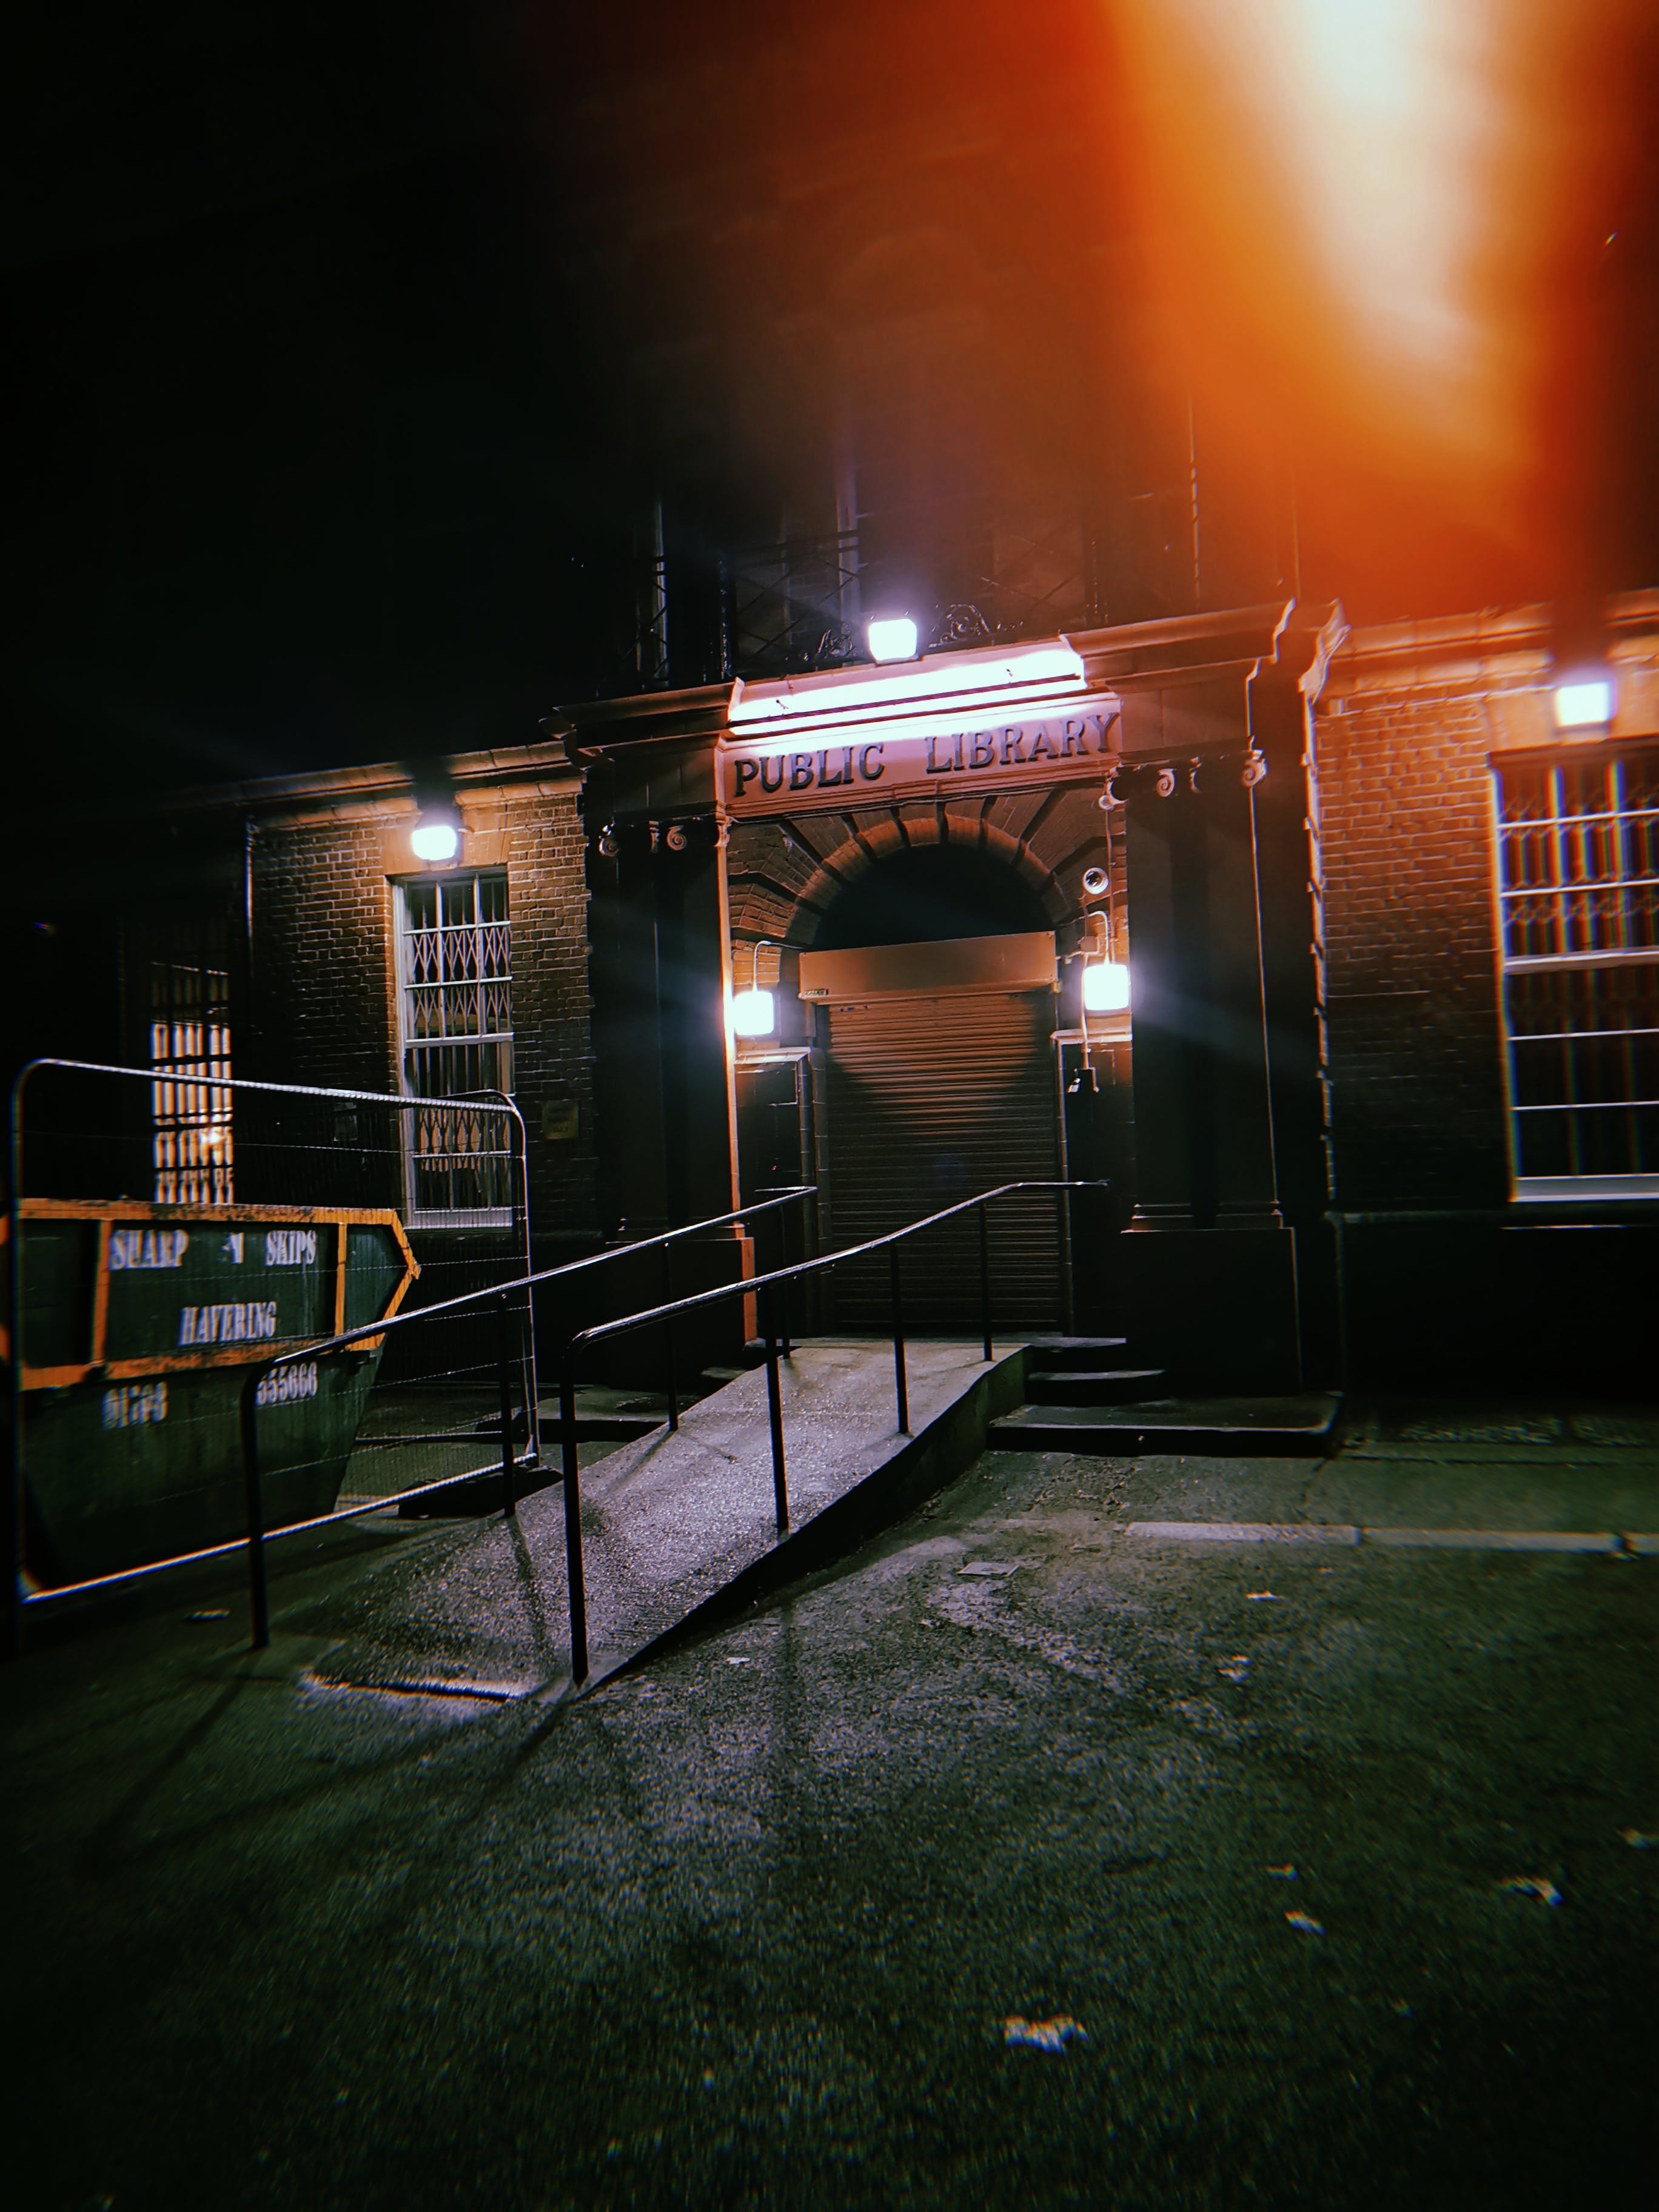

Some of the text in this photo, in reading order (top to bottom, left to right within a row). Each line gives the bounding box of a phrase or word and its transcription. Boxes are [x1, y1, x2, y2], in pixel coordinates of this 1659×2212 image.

[734, 712, 1120, 797] PUBLIC LIBRARY
[265, 1229, 317, 1267] SKIPS
[178, 1301, 276, 1347] HAVERING
